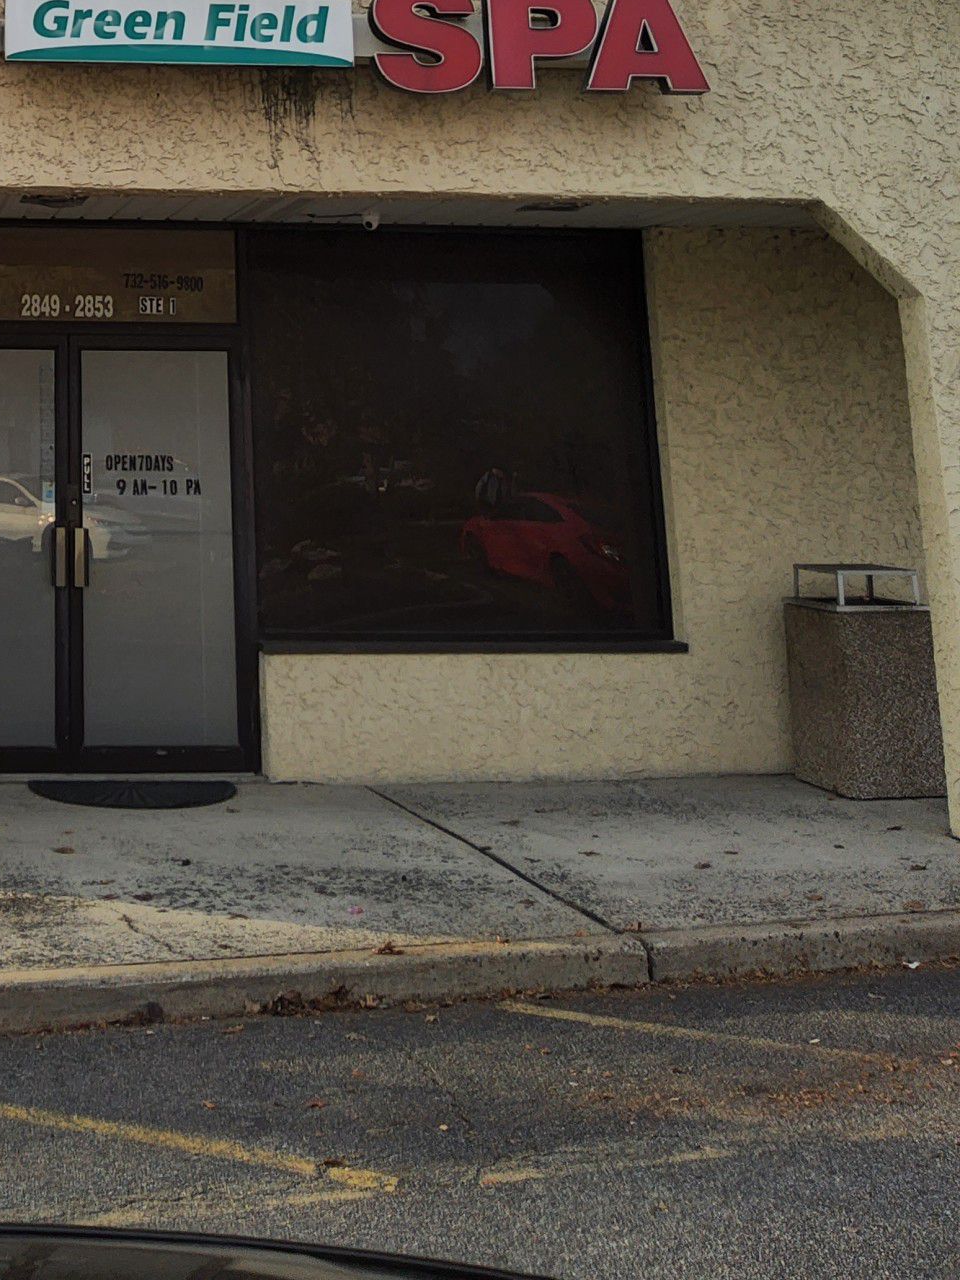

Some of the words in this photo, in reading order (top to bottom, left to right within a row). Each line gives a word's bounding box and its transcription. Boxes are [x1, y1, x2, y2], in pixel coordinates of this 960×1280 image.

[32, 0, 185, 41] Green
[203, 3, 328, 43] Field
[123, 272, 204, 292] 732-516-9800
[21, 294, 61, 317] 2849
[74, 295, 114, 317] 2853
[140, 297, 164, 314] STE
[170, 298, 177, 315] 1
[83, 457, 92, 493] PULL
[116, 479, 127, 496] 9
[162, 479, 178, 496] 10
